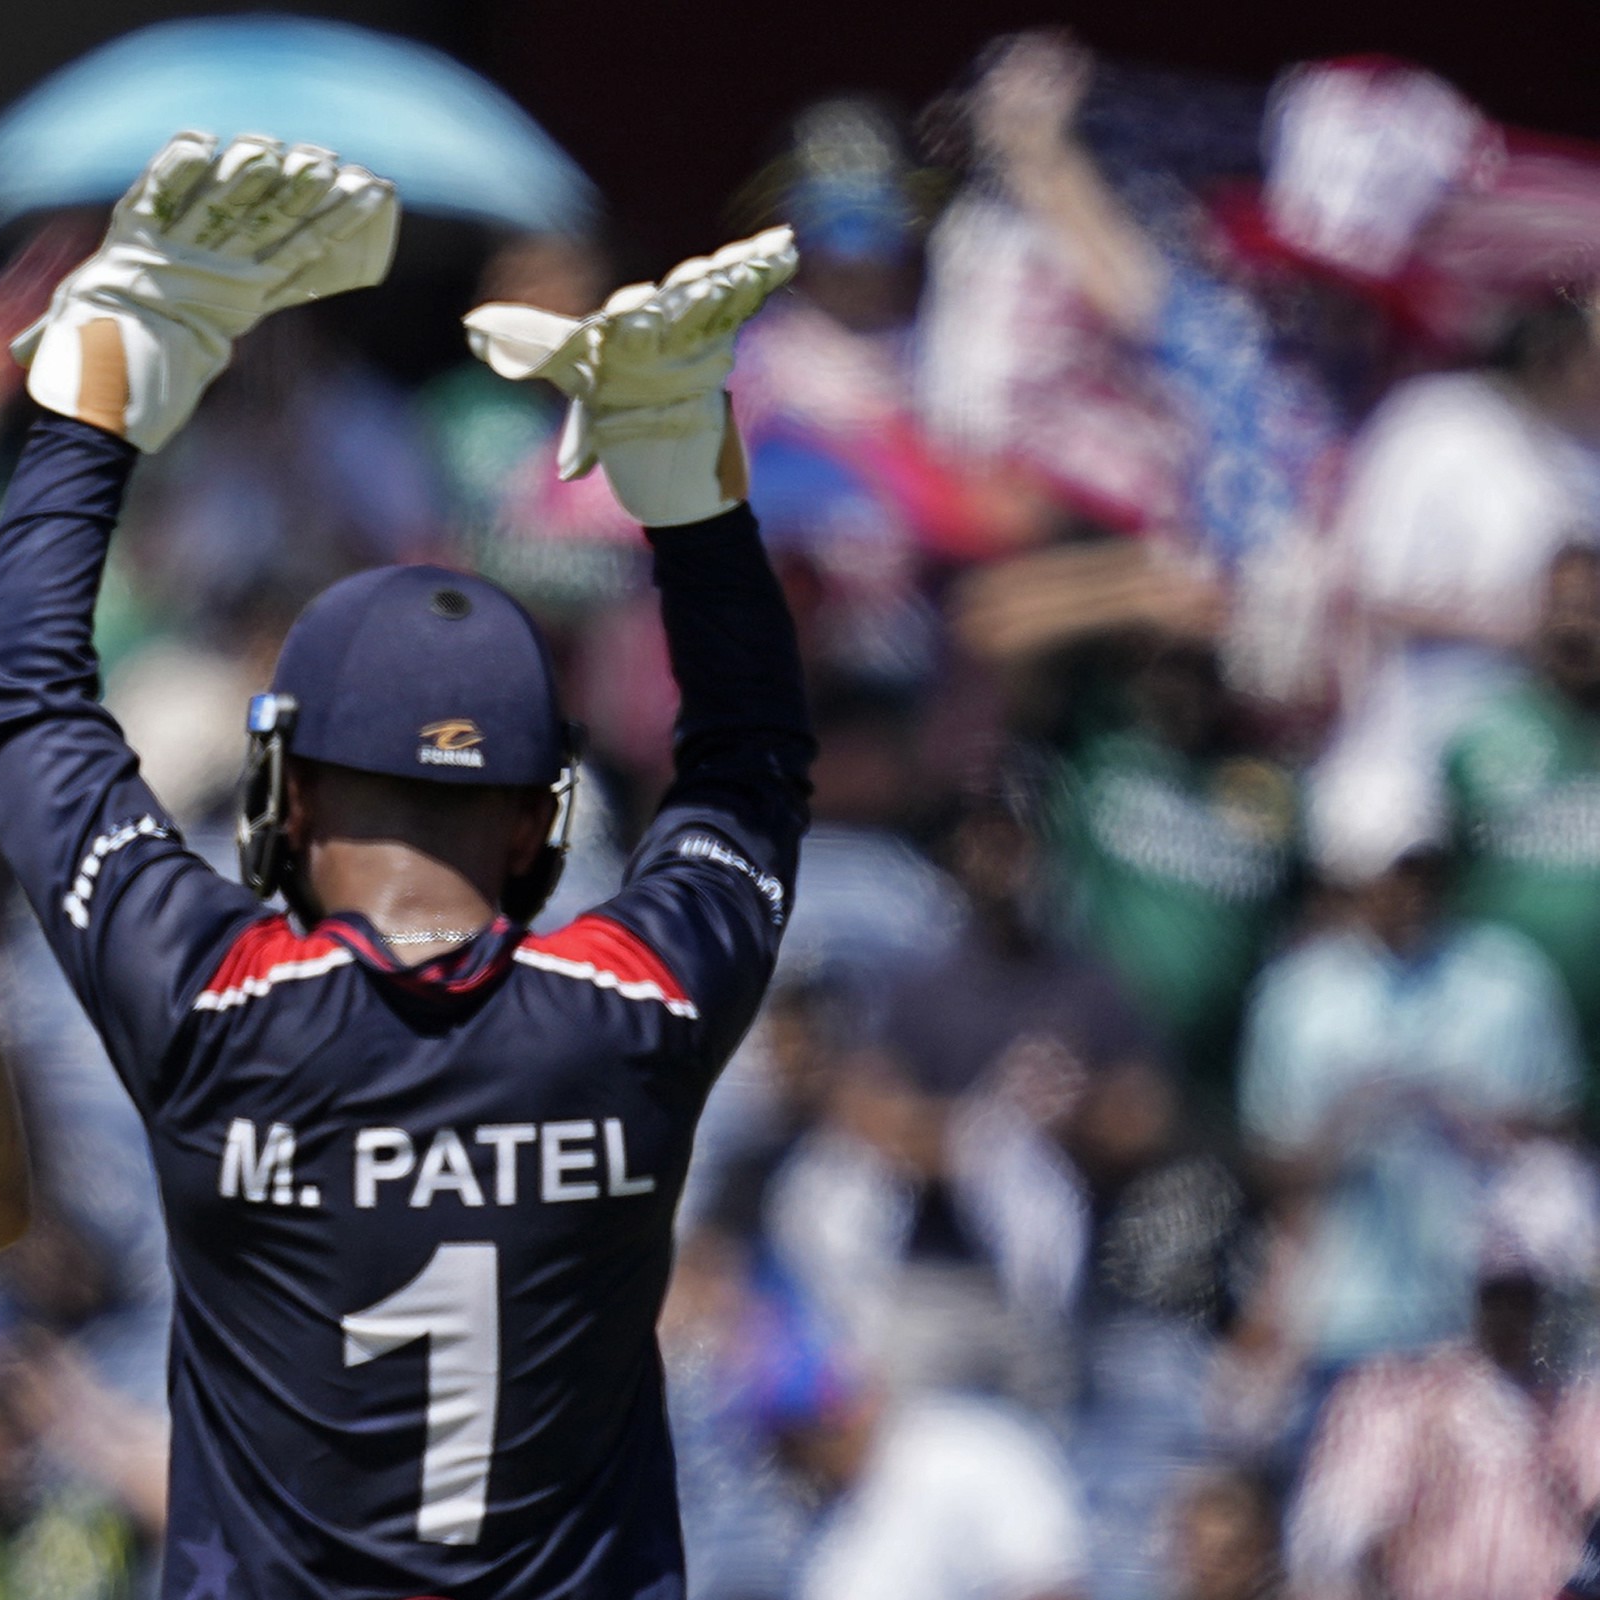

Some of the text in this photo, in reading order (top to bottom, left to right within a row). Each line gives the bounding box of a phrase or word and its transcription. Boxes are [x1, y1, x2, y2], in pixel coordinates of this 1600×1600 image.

[218, 1118, 655, 1208] M. PATEL
[341, 1241, 499, 1546] 1
